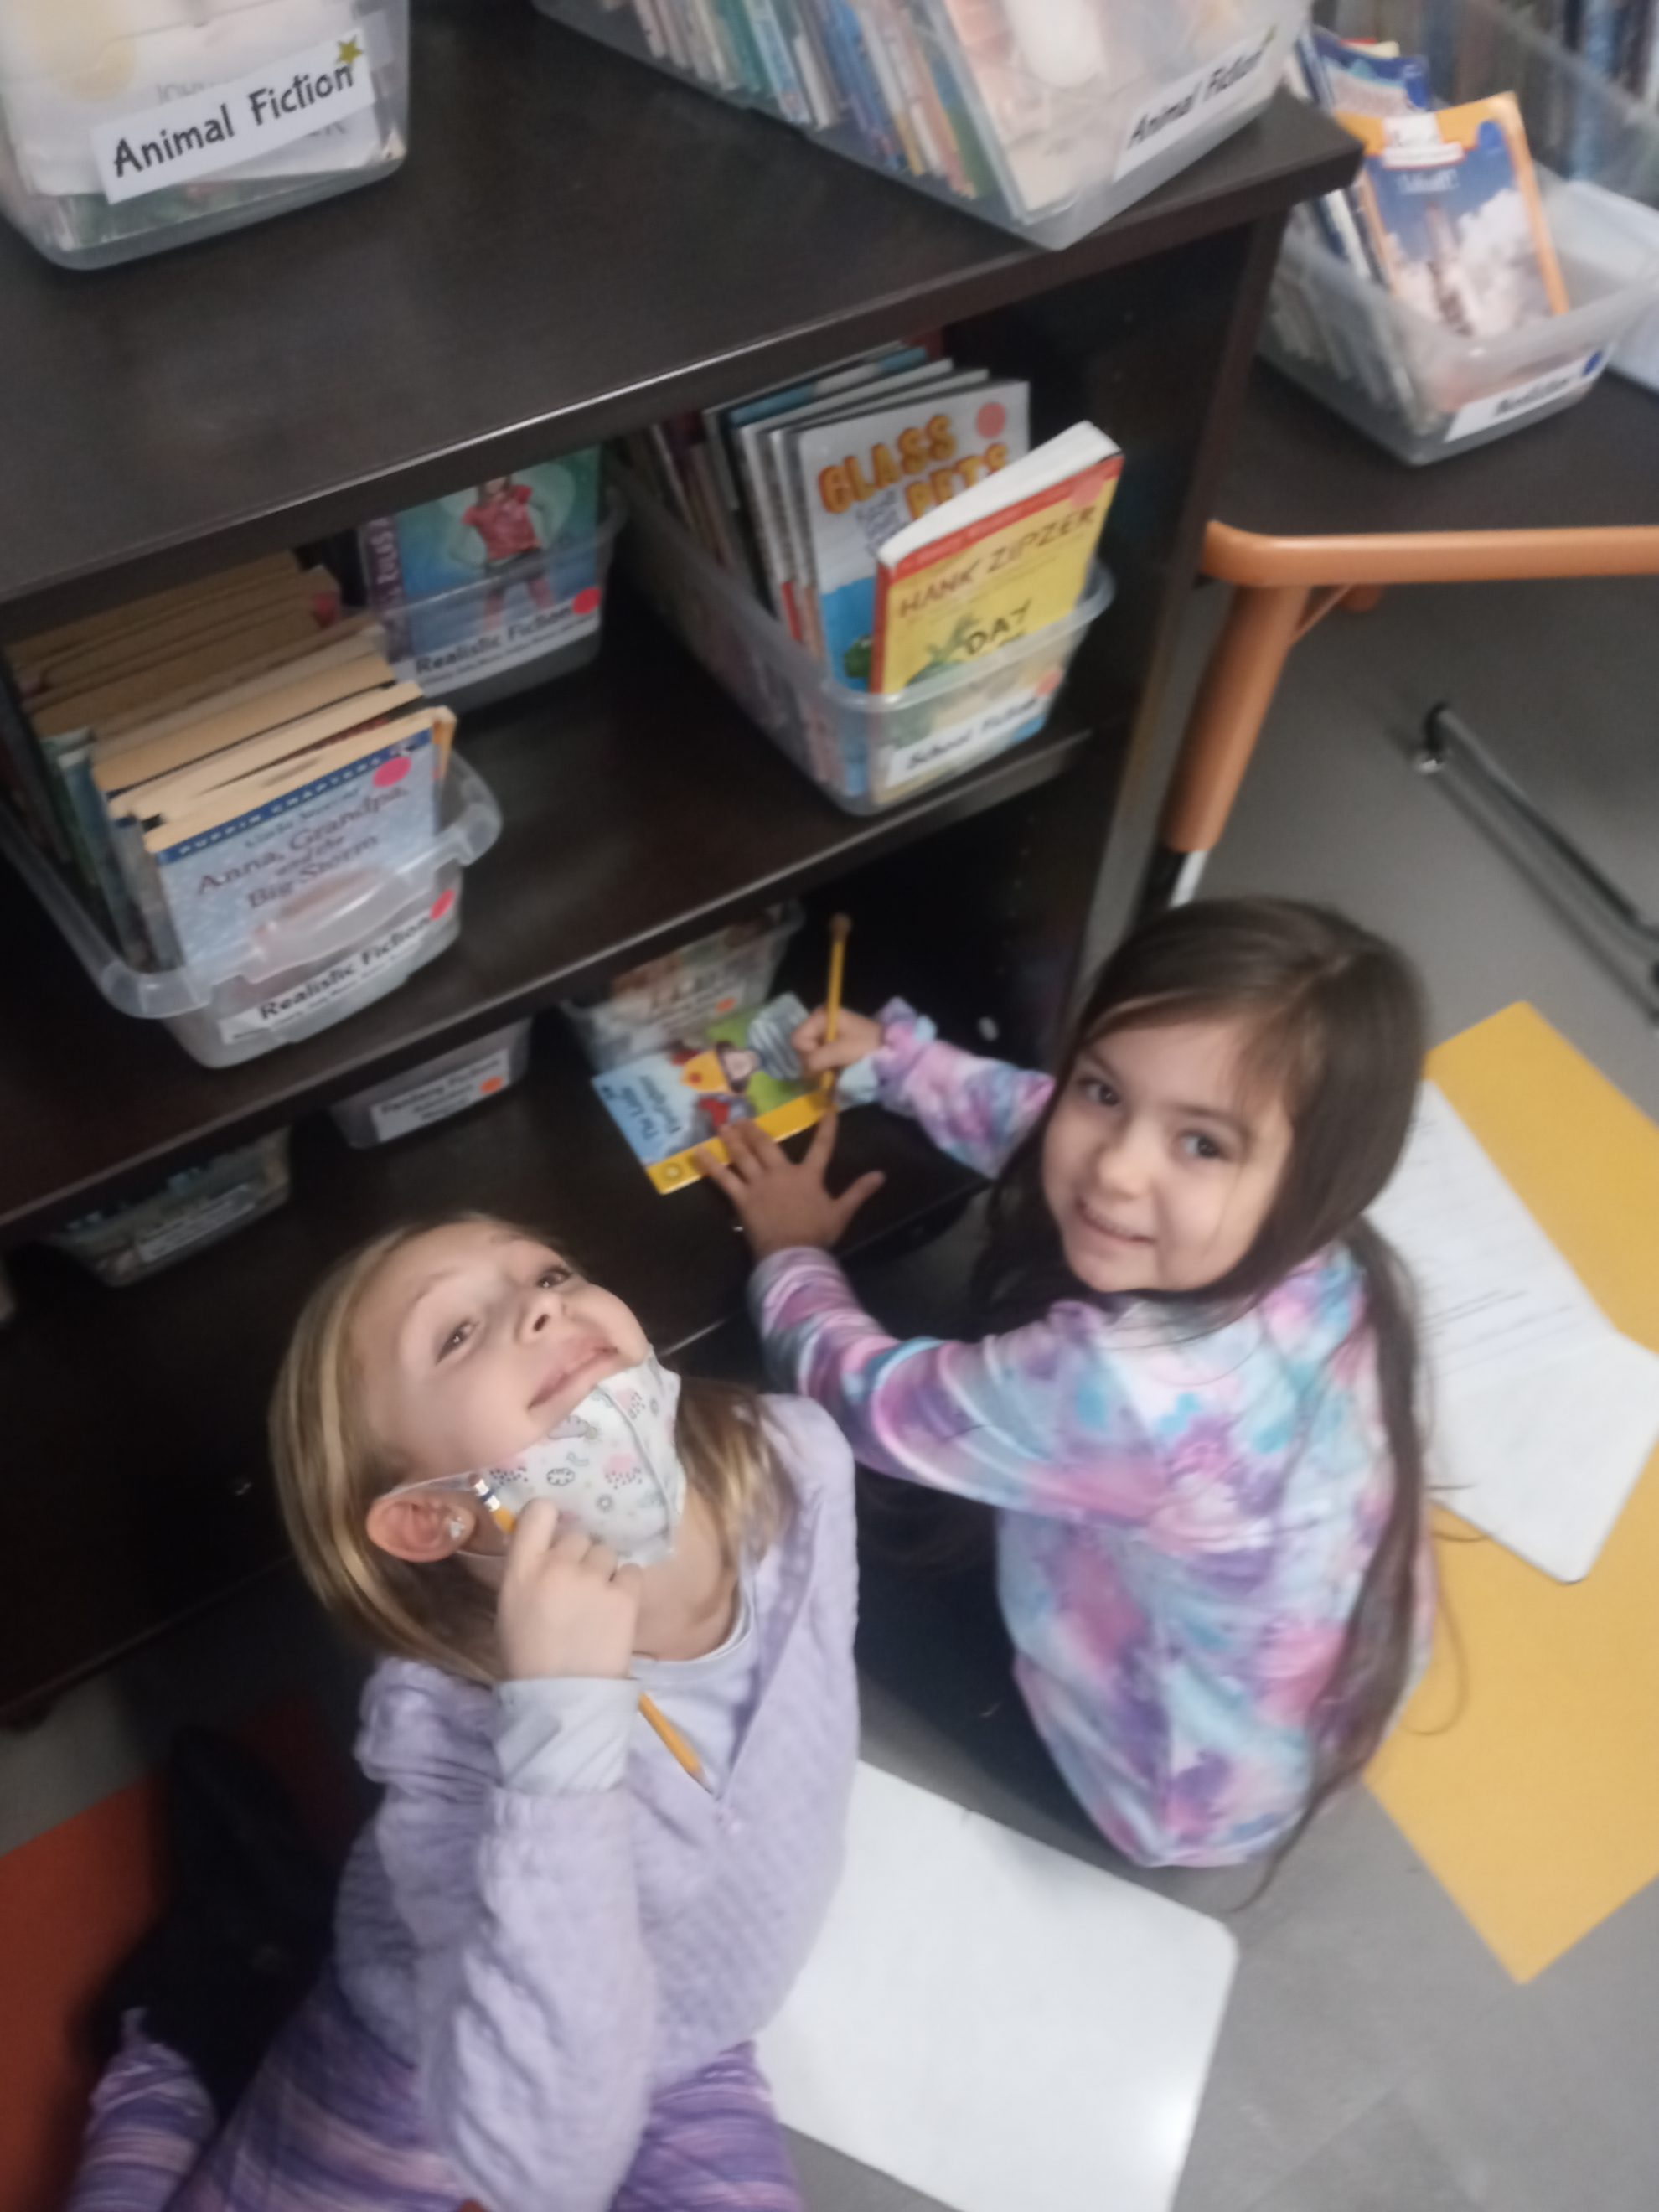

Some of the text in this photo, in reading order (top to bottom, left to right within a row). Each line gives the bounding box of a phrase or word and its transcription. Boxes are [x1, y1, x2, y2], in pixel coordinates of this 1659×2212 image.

[113, 64, 354, 178] Animal Fiction
[1127, 80, 1203, 151] Animal
[897, 558, 982, 618] HANK
[986, 505, 1097, 574] ZIPZER
[416, 635, 501, 674] Realistic
[965, 597, 1032, 657] DAY
[258, 964, 354, 1020] Realistic
[362, 916, 431, 965] Fiction
